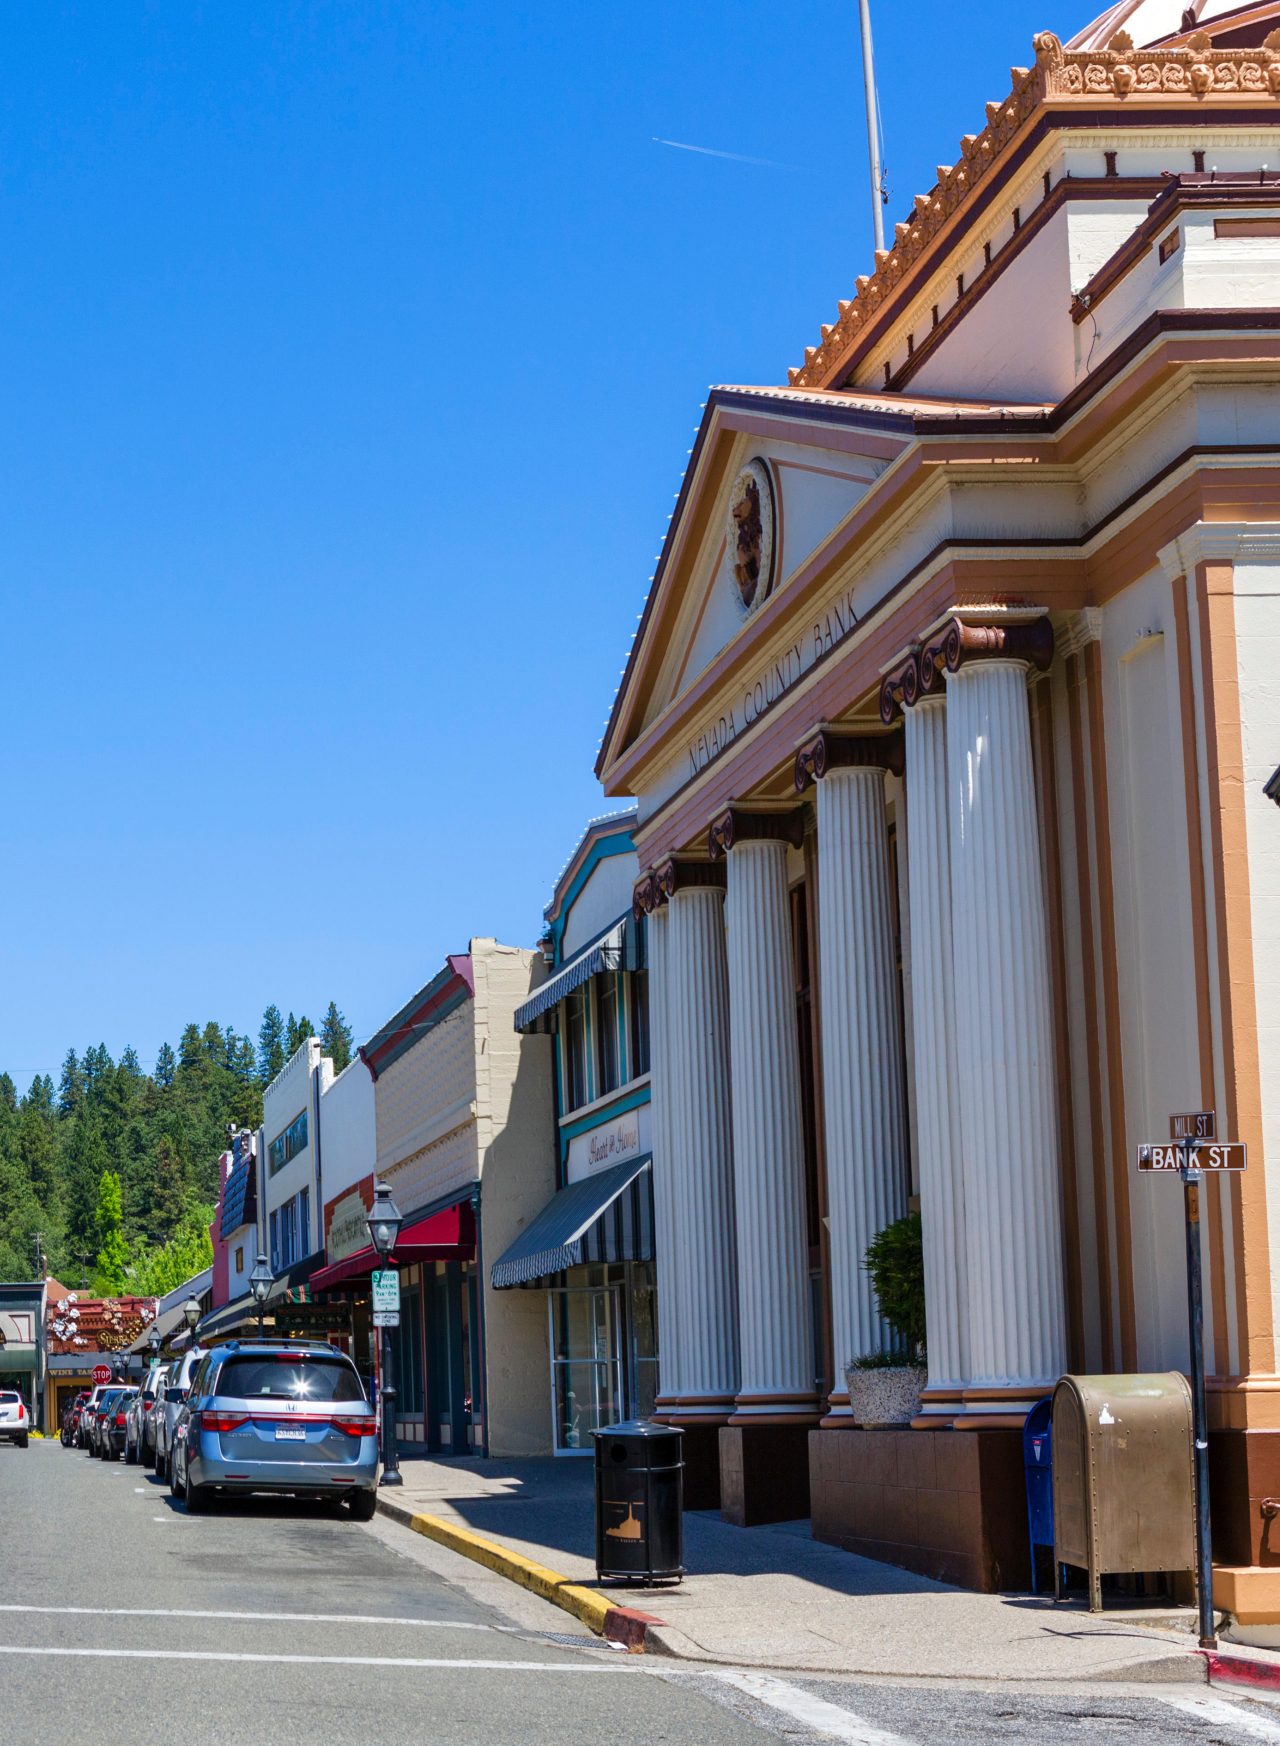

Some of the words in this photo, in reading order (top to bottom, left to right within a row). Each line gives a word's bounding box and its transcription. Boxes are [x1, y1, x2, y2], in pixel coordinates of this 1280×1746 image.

[689, 709, 736, 778] NEVADA
[744, 639, 803, 724] COUNTY
[813, 587, 859, 660] BANK
[1174, 1117, 1193, 1137] MILL
[1197, 1116, 1207, 1136] ST
[1152, 1147, 1201, 1169] BANK
[1208, 1146, 1231, 1168] ST
[92, 1370, 111, 1379] STOP
